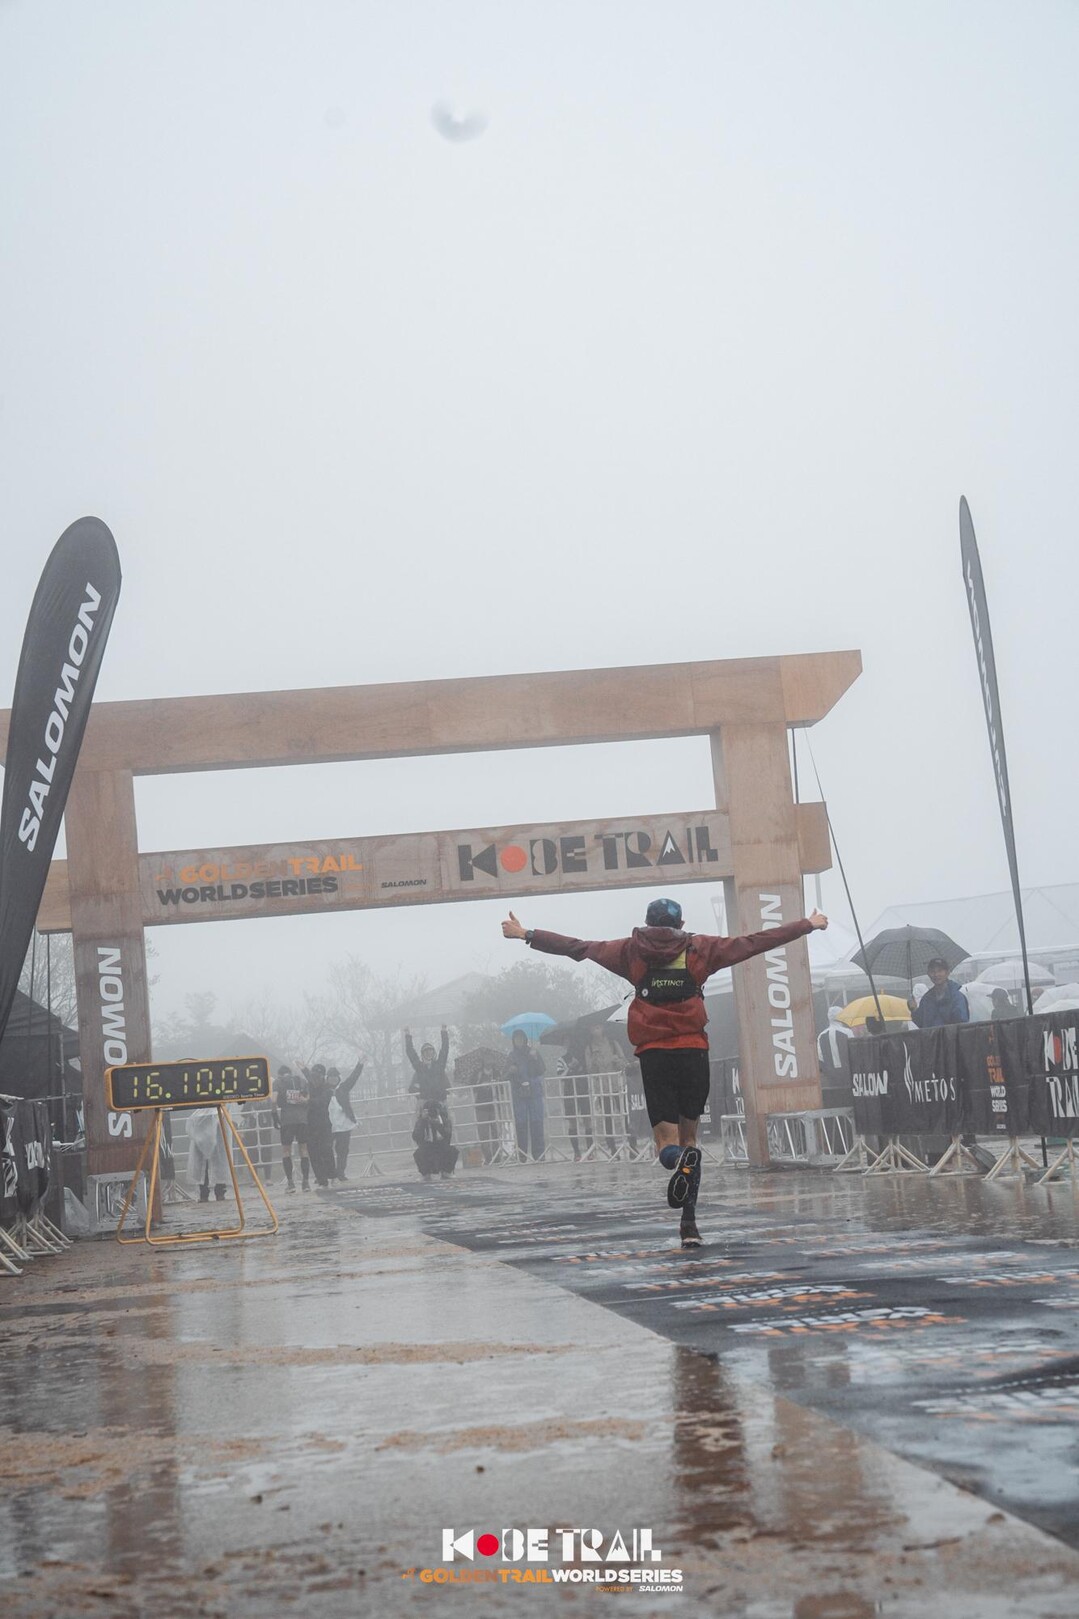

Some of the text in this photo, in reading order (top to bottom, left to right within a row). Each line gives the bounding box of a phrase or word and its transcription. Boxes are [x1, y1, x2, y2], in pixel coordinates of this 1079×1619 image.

[18, 582, 102, 852] SALOMON
[381, 879, 427, 888] SALOMON
[458, 825, 719, 881] KOBE TRAIL
[97, 946, 133, 1138] SOMON
[759, 893, 798, 1078] SALOMN
